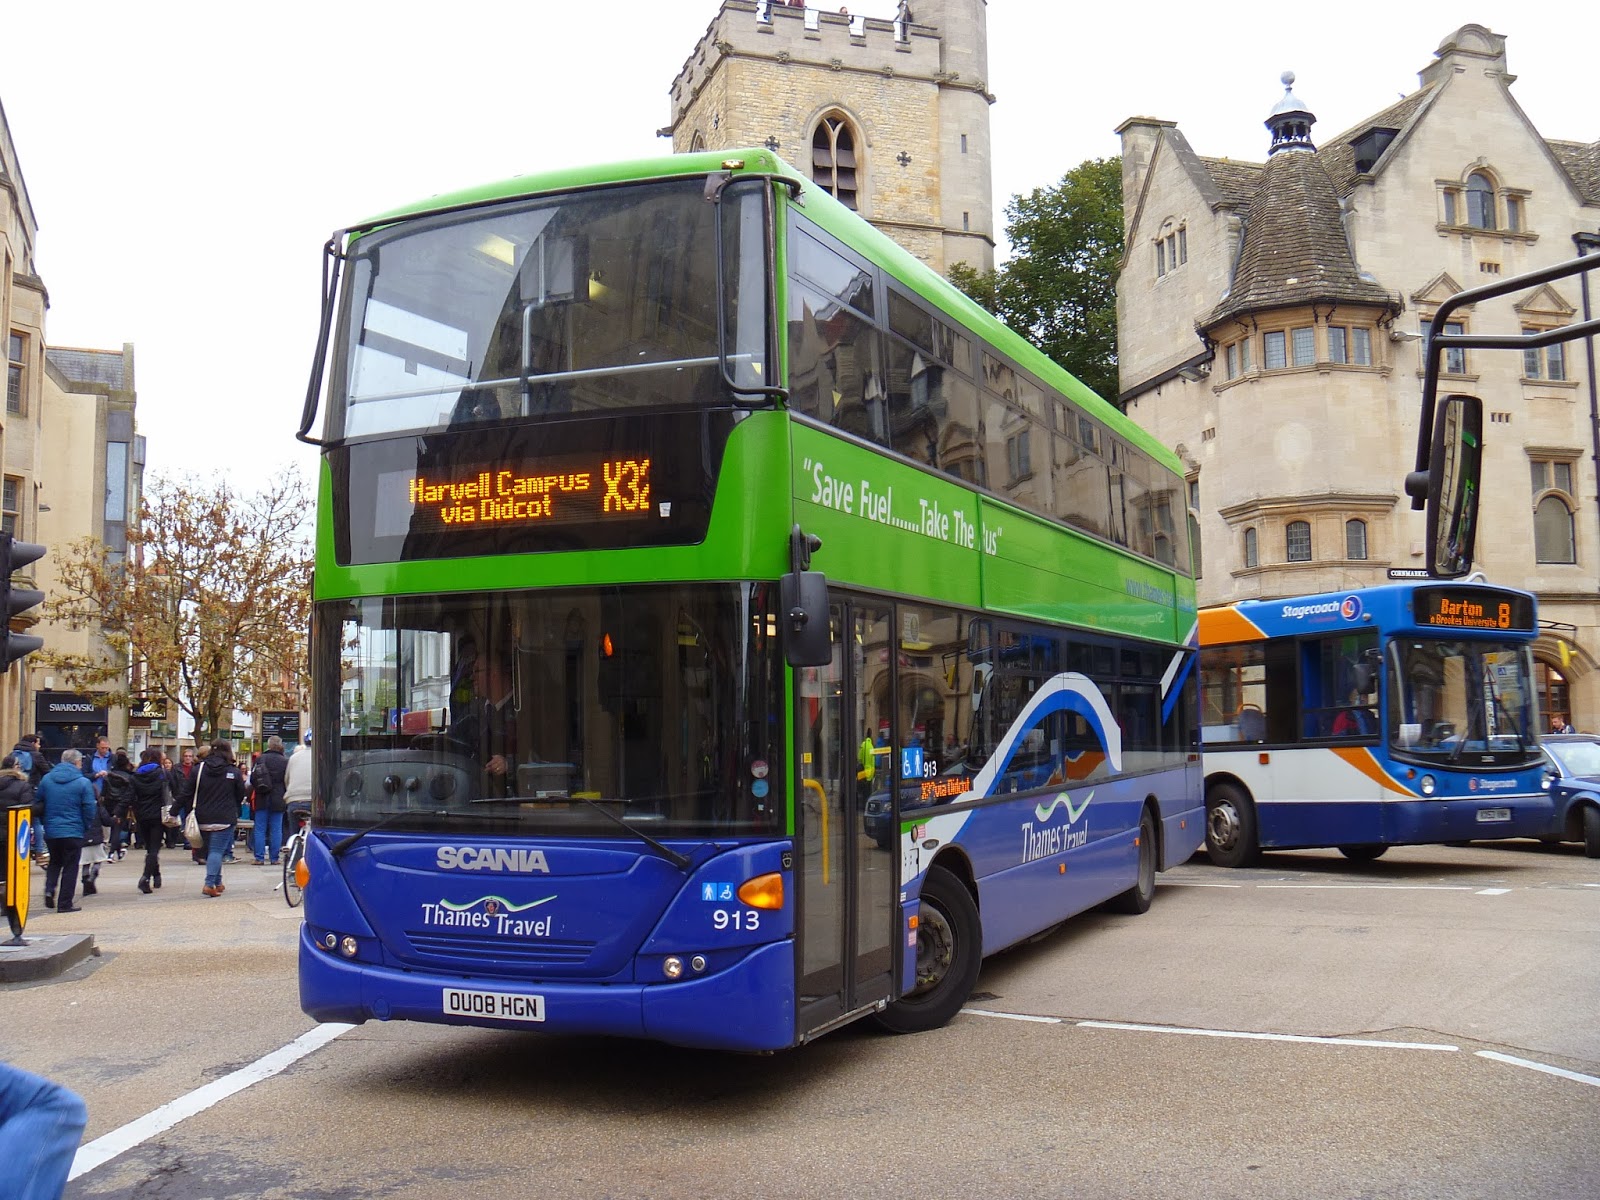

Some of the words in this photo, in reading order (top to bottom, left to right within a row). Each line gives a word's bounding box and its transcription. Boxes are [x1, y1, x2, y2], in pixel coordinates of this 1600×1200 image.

[408, 472, 491, 503] Harwell
[497, 470, 591, 496] Campus
[441, 501, 476, 524] via
[480, 495, 552, 521] Didcot
[953, 510, 975, 549] The
[979, 521, 1003, 556] us"
[1281, 601, 1340, 619] Stagecoach
[1436, 613, 1462, 626] Brookes
[1463, 615, 1497, 628] University
[1440, 598, 1483, 617] Barton
[1498, 602, 1511, 628] 8
[49, 703, 95, 712] SWAROVSKI
[923, 760, 937, 778] 913
[1021, 822, 1061, 864] Thames
[436, 846, 550, 873] SCANIA
[421, 903, 490, 928] Thames
[494, 913, 552, 937] Travel
[713, 909, 760, 930] 913
[450, 992, 496, 1014] OU08
[501, 996, 538, 1017] HGN
